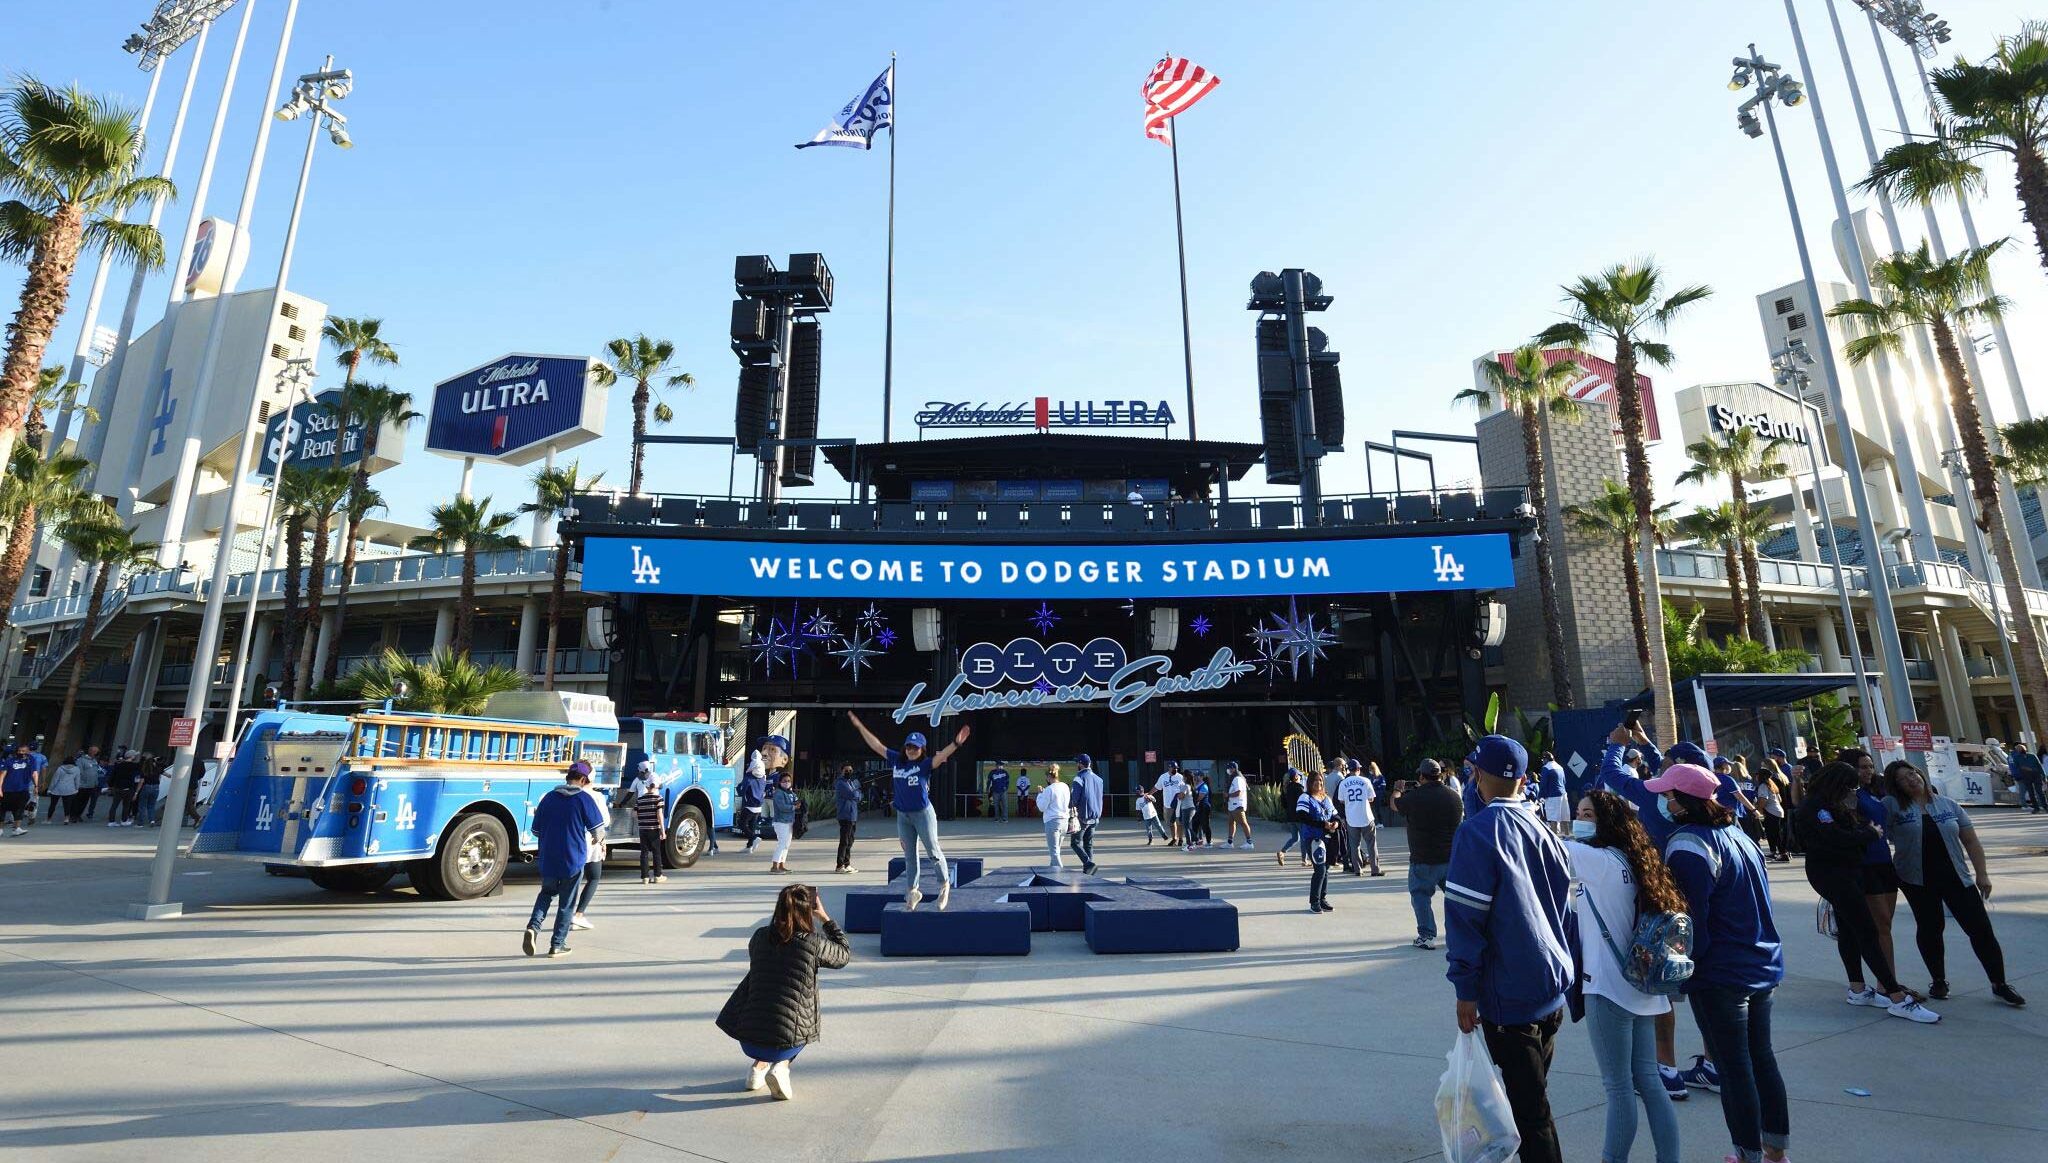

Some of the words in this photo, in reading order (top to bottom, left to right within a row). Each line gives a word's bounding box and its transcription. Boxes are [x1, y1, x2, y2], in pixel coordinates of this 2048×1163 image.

[832, 128, 866, 138] WORLD
[478, 359, 542, 385] Michelob
[461, 378, 550, 414] ULTRA
[914, 401, 1029, 427] Michelob
[1058, 400, 1177, 425] ULTRA
[631, 545, 661, 584] LA
[749, 557, 923, 582] WELCOME
[940, 560, 983, 583] TO
[1001, 559, 1143, 584] DODGER
[1162, 556, 1331, 582] STADIUM
[1431, 545, 1465, 582] LA
[973, 652, 1115, 674] BLUE
[892, 673, 1050, 728] Heaven
[1055, 686, 1098, 702] on
[1108, 646, 1256, 714] Earth
[908, 776, 919, 786] 22
[1965, 777, 1983, 795] LA
[1347, 788, 1363, 802] 22
[255, 795, 273, 831] LA
[394, 793, 417, 831] LA
